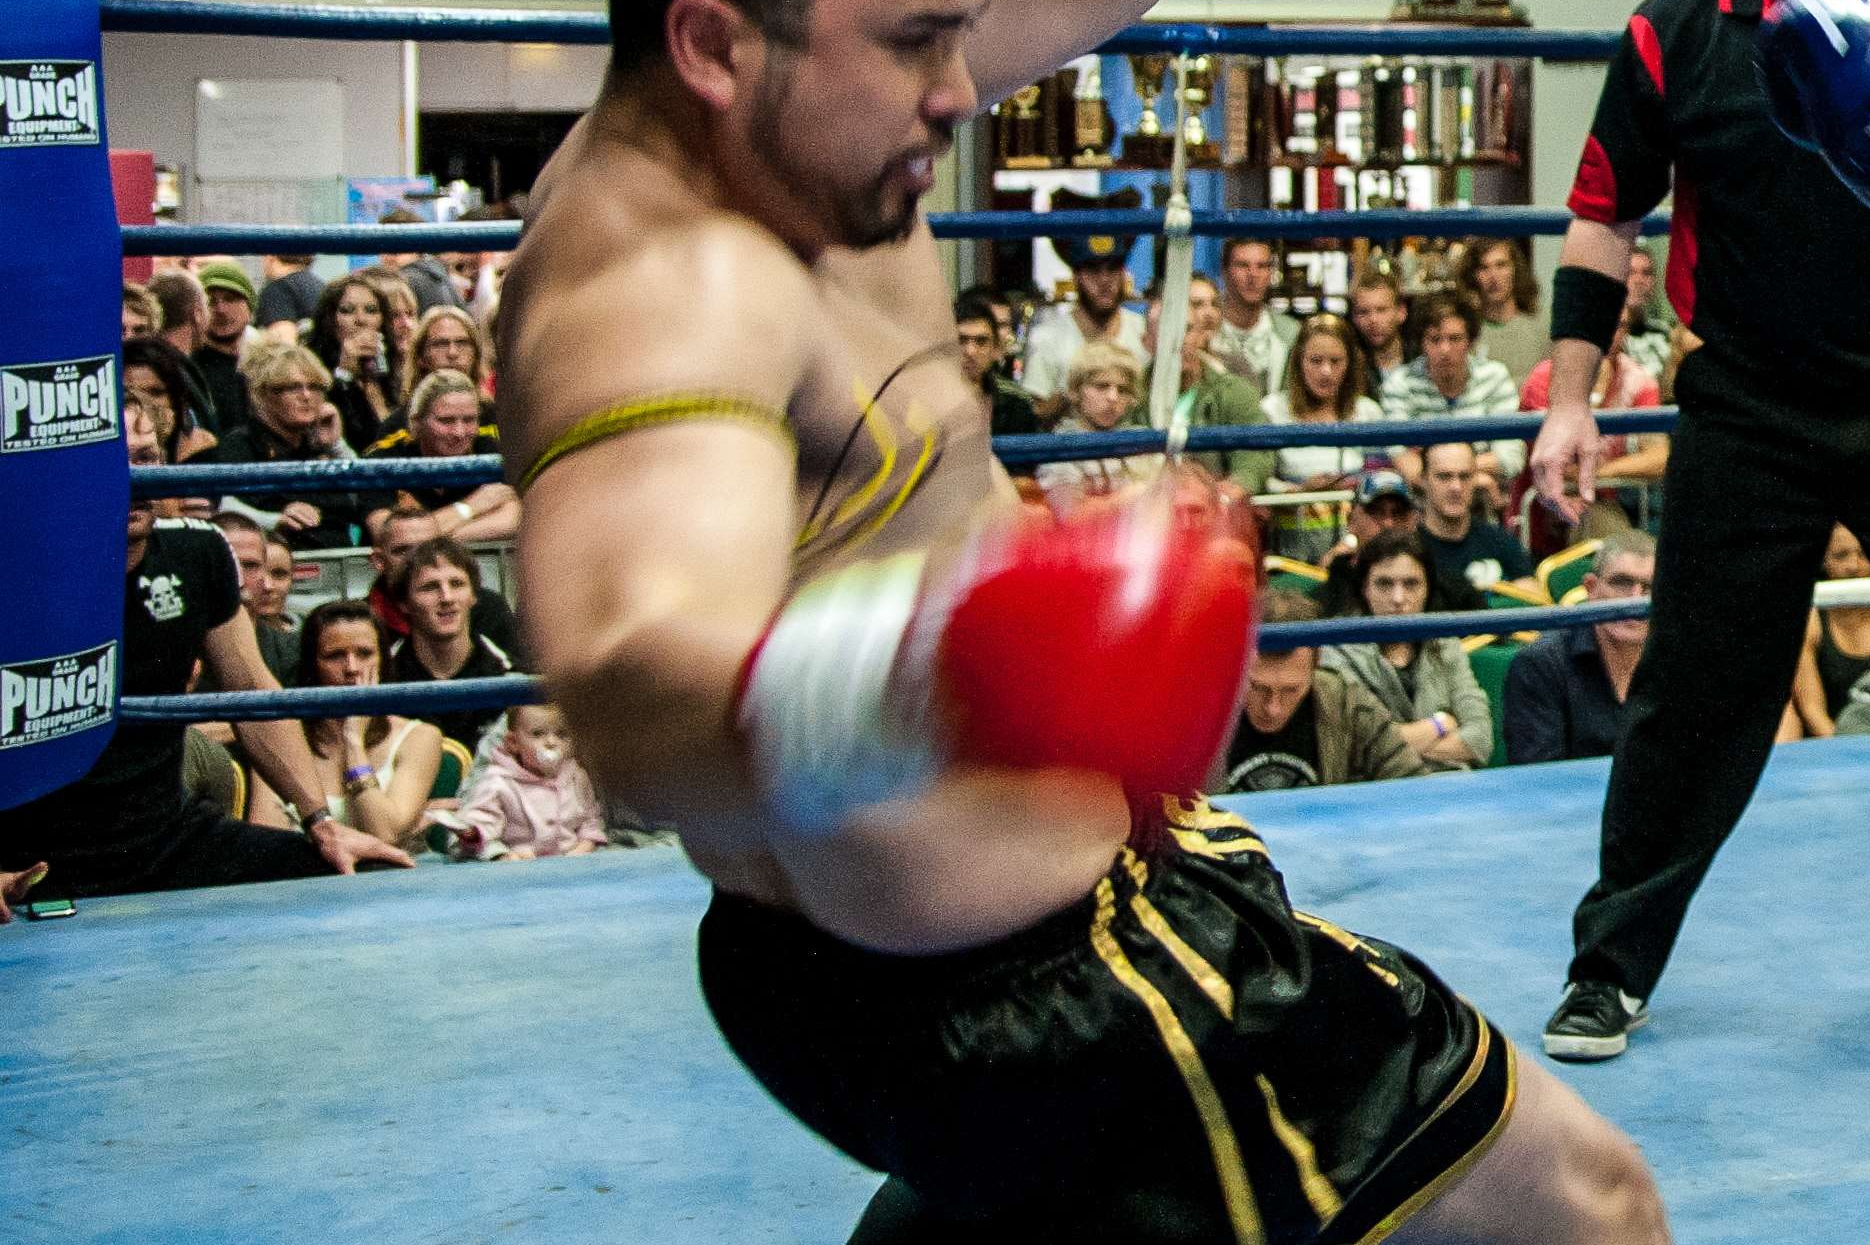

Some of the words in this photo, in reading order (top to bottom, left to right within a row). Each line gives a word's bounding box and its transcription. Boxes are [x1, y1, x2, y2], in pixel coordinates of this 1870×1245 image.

[2, 359, 116, 441] PUNCH
[30, 416, 101, 439] EQUIPMENT
[1, 644, 115, 737] PUNCH
